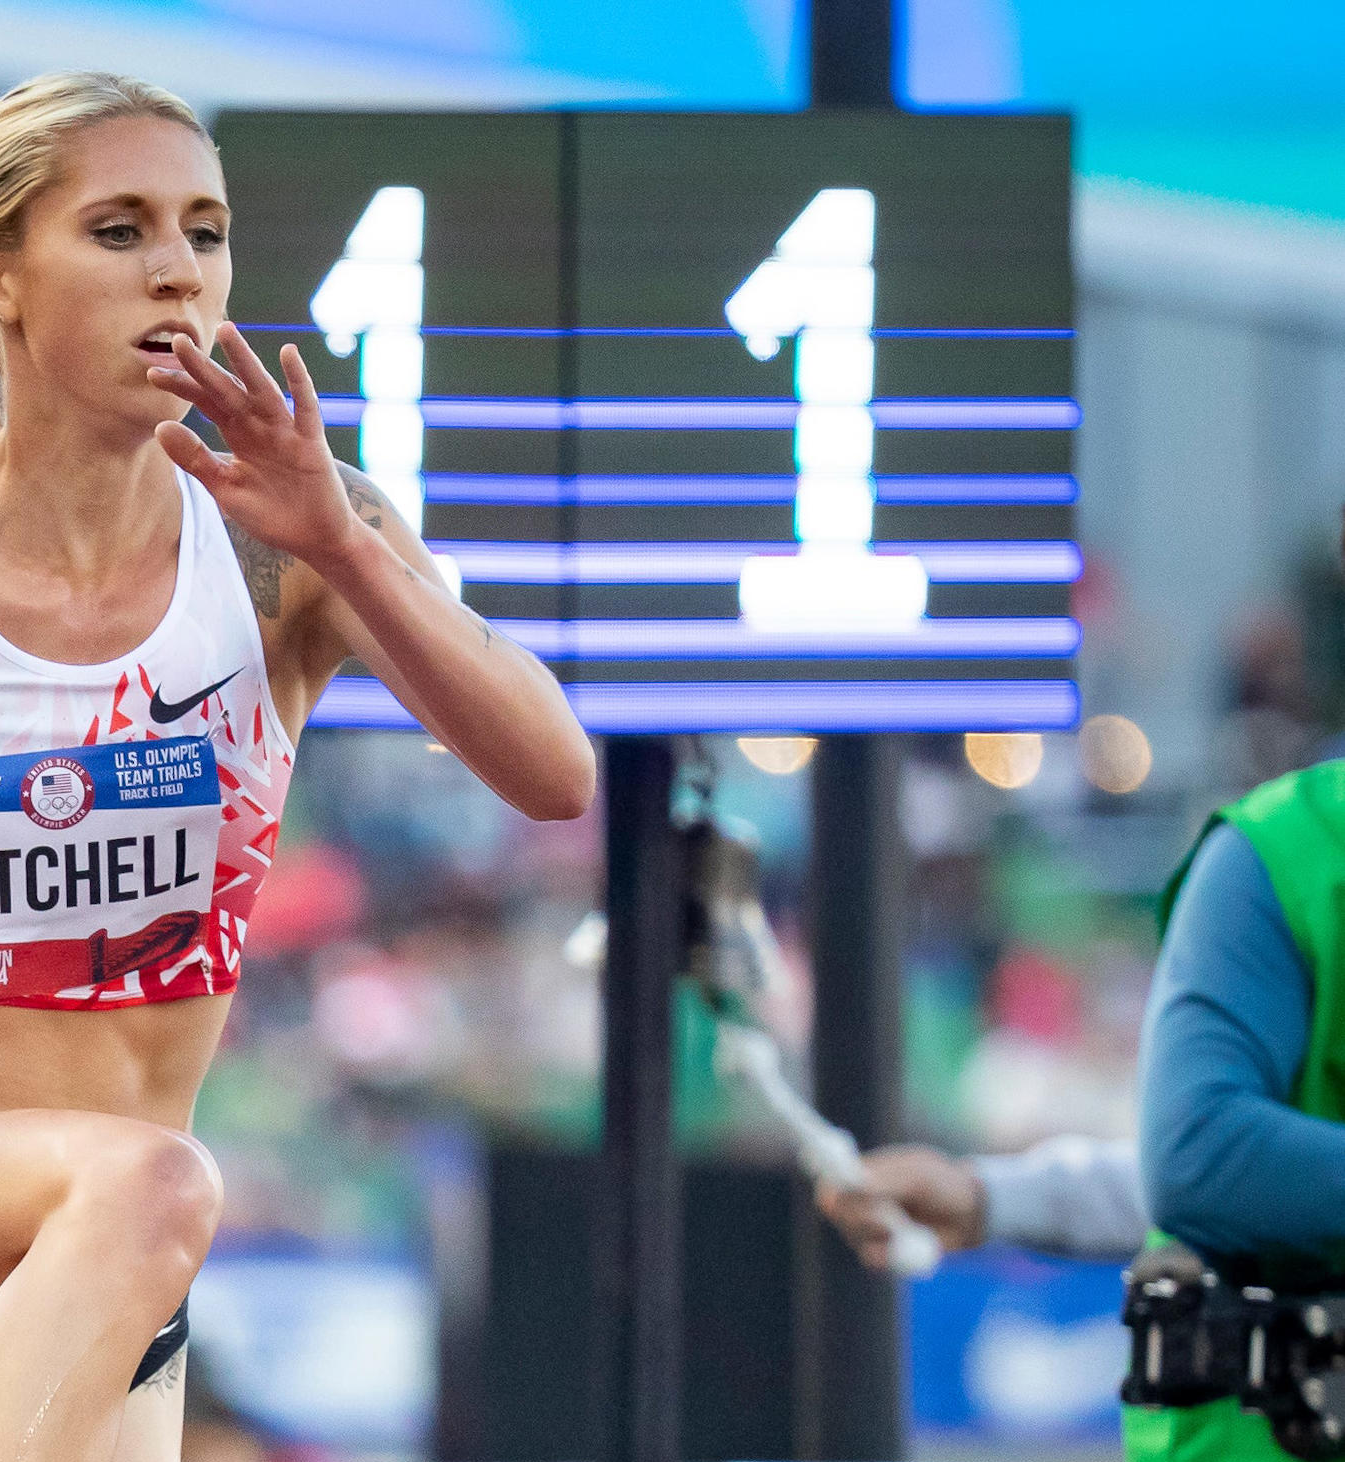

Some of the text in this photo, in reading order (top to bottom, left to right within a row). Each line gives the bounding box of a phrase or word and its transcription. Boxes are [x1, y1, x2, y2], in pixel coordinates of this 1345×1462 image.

[114, 742, 200, 769] U.S. OLYMPIC
[115, 760, 202, 787] TEAM TRIALS
[119, 782, 184, 801] TRACK & FIELD
